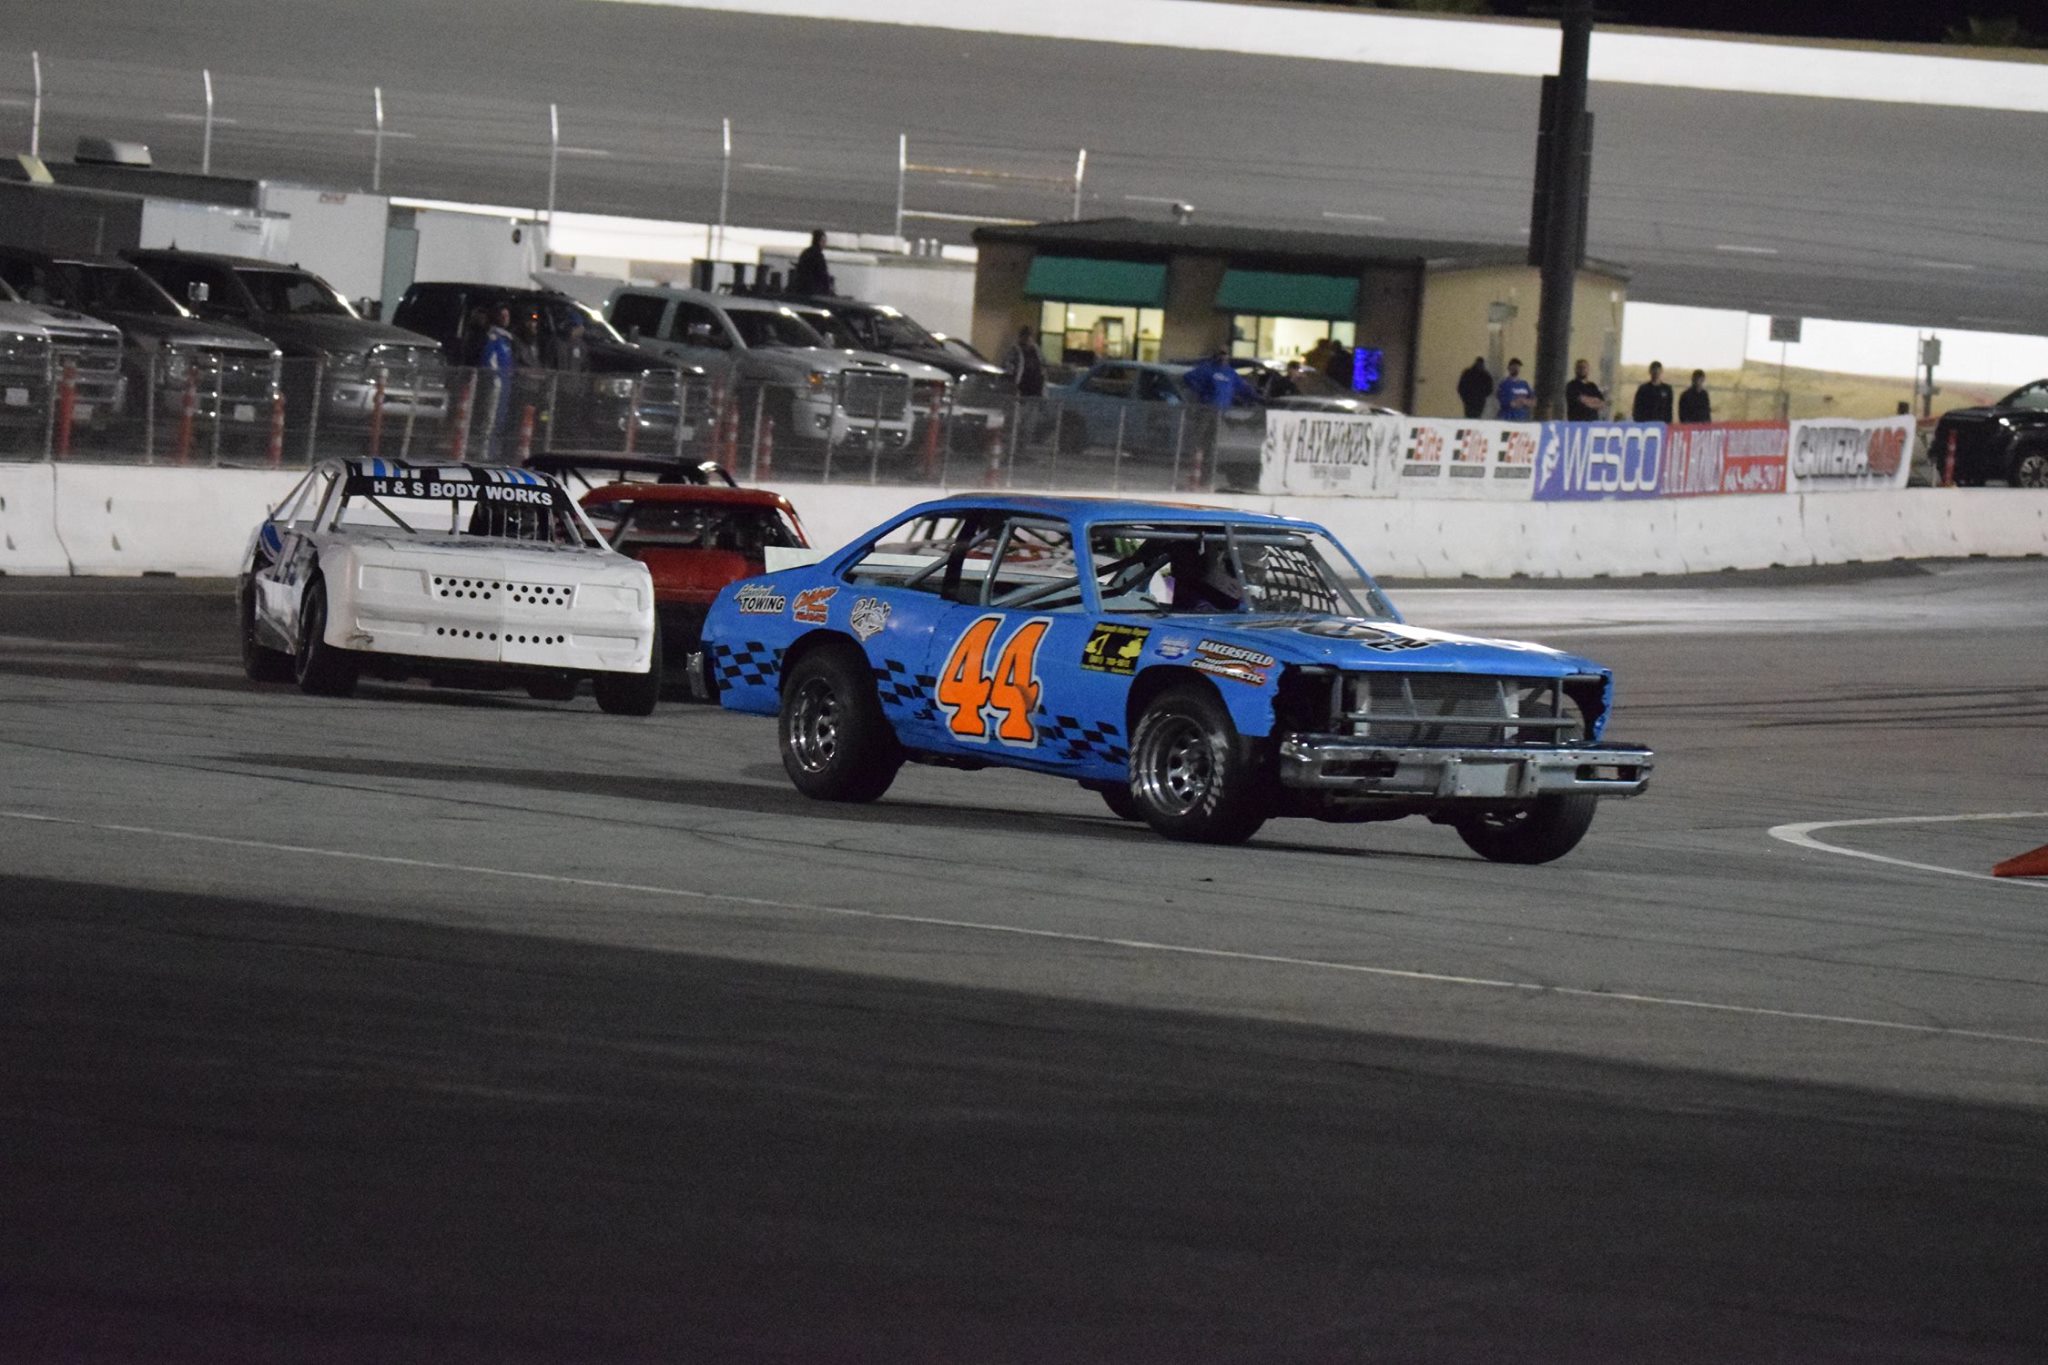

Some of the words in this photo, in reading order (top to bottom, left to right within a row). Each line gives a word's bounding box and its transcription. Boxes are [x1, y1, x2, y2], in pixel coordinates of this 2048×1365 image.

[1563, 426, 1661, 492] WESCO
[373, 480, 388, 495] H
[393, 480, 407, 495] &
[412, 481, 425, 497] S
[429, 482, 480, 499] BODY
[485, 485, 553, 507] WORKS
[740, 596, 786, 612] TOWING
[1197, 640, 1275, 666] BAKERSFIELD
[936, 614, 1053, 747] 44
